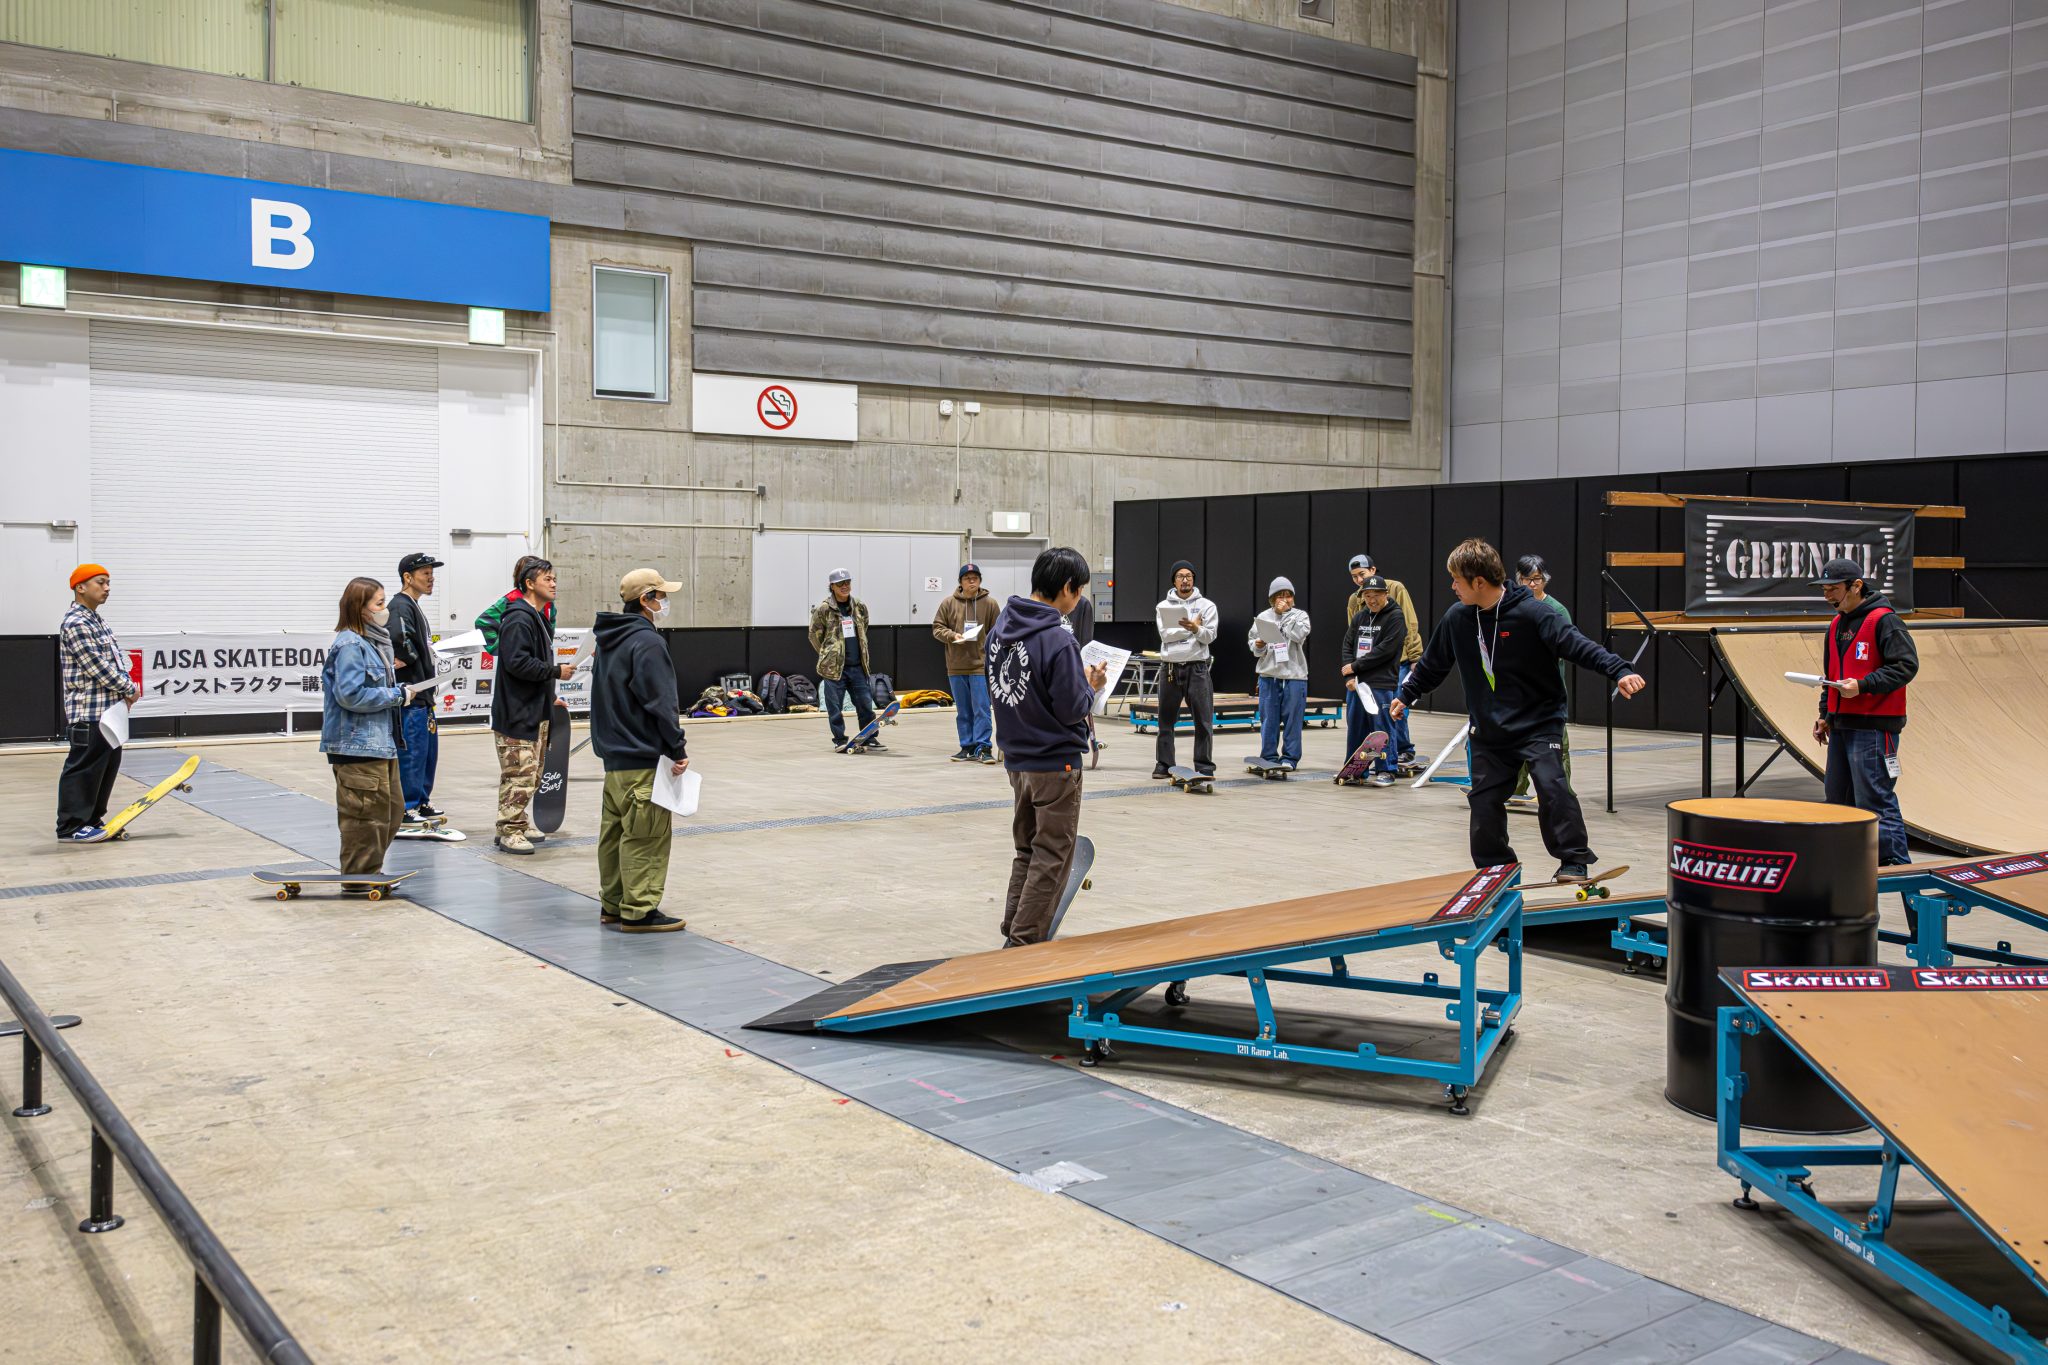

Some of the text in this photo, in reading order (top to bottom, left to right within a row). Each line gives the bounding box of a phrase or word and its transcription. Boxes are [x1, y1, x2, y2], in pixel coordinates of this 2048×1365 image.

[251, 198, 315, 270] B
[153, 648, 330, 670] AJSA SKATEBOA
[153, 676, 324, 695] インストラクター講
[1670, 845, 1781, 885] SKATELITE
[1717, 854, 1786, 865] SURFACE
[1983, 860, 2043, 874] SKATELITE
[1750, 972, 1880, 986] SKATELITE
[1919, 971, 2048, 985] SKATELITE
[1251, 1046, 1272, 1057] Ramp
